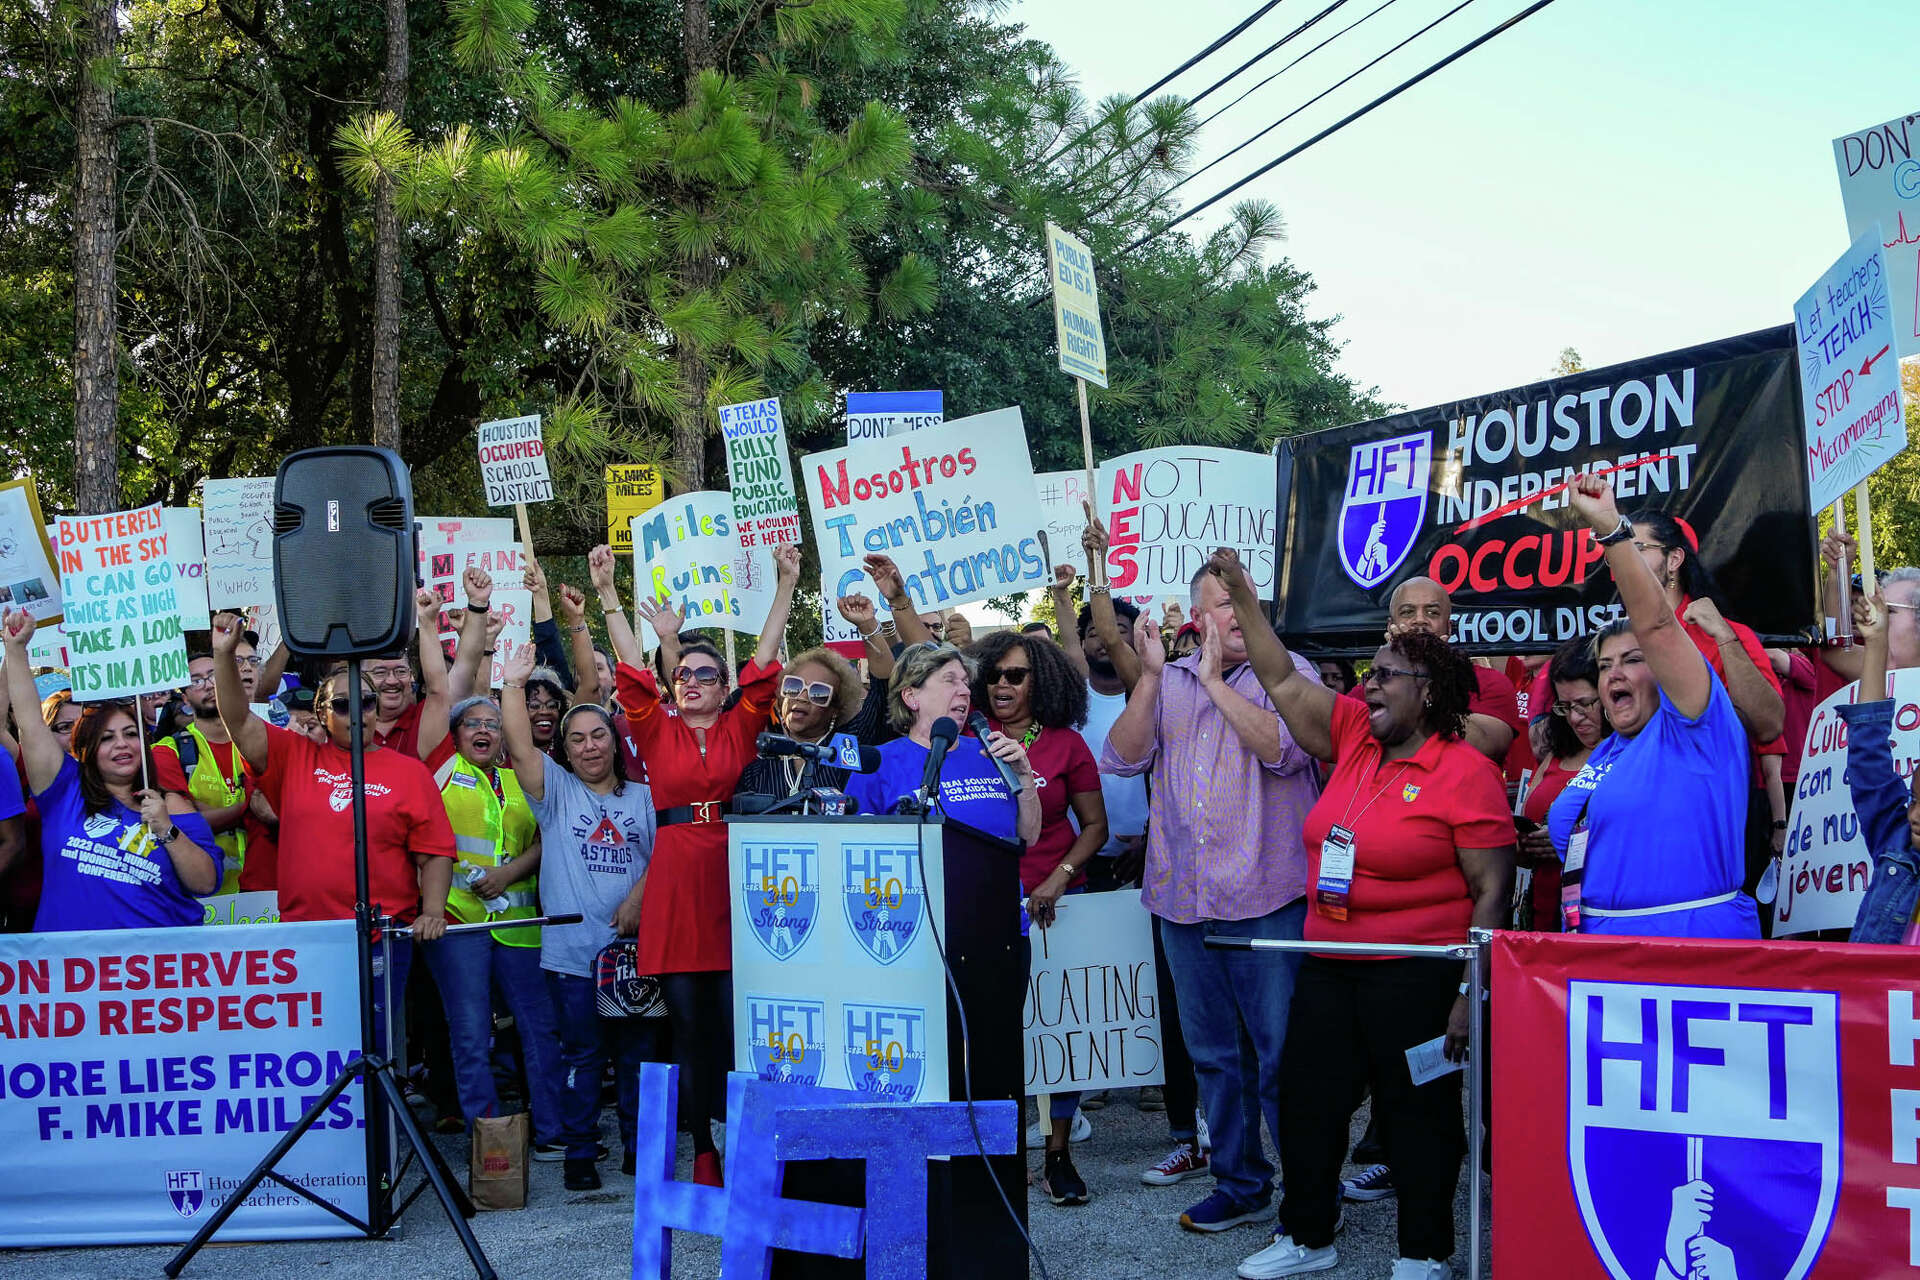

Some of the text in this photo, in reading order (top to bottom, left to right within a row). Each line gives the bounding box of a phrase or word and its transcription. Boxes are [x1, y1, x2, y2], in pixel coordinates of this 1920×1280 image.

[1842, 114, 1920, 177] DON'
[1055, 238, 1089, 274] PUBLIC
[1058, 261, 1092, 297] ED IS A
[1798, 253, 1880, 344] Let teachers
[1062, 307, 1098, 342] HUMAN
[1818, 294, 1873, 366] TEACH
[1066, 331, 1099, 362] RIGHT!
[720, 400, 778, 424] IF TEXAS
[1815, 369, 1854, 427] STOP
[482, 420, 538, 443] HOUSTON
[723, 417, 778, 439] WOULD
[1449, 368, 1696, 467] HOUSTON
[479, 440, 544, 464] OCCUPIED
[729, 434, 778, 461] FULLY
[1808, 390, 1900, 482] Micromanaging
[486, 461, 542, 483] SCHOOL
[733, 456, 781, 484] FUND
[817, 446, 977, 510] Nosotros
[1112, 457, 1220, 505] NOT
[1351, 438, 1426, 499] HFT
[489, 480, 551, 503] DISTRICT
[616, 485, 653, 497] MILES
[732, 481, 788, 502] PUBLIC
[59, 506, 162, 546] BUTTERFLY
[642, 503, 730, 563] Miles
[737, 521, 753, 534] WE
[740, 527, 798, 548] BE HERE!
[825, 490, 997, 558] También
[1109, 501, 1275, 547] EDUCATING
[61, 532, 168, 574] IN THE SKY
[65, 561, 172, 596] I CAN GO
[651, 561, 733, 605] Ruins
[63, 599, 113, 625] TWICE
[115, 596, 138, 620] AS
[141, 587, 177, 616] HIGH
[66, 614, 184, 654] TAKE A LOOK
[71, 662, 101, 691] IT'S
[106, 662, 127, 689] IN
[131, 658, 145, 687] A
[149, 649, 189, 684] BOOK
[941, 780, 962, 788] REAL
[944, 786, 964, 796] FOR
[965, 785, 987, 793] KIDS
[1799, 766, 1832, 800] con
[66, 836, 93, 851] 2023
[1787, 811, 1858, 858] de nu
[581, 844, 632, 864] ASTROS
[745, 848, 815, 890] HFT
[845, 849, 919, 891] HFT
[762, 876, 799, 907] 50
[864, 877, 903, 910] 50
[1780, 860, 1869, 922] jóven
[754, 907, 810, 935] Strong
[855, 910, 916, 939] Strong
[64, 949, 298, 993] DESERVES
[99, 992, 323, 1036] RESPECT!
[751, 1003, 820, 1043] HFT
[847, 1010, 921, 1052] HFT
[768, 1032, 805, 1063] 50
[866, 1039, 904, 1073] 50
[1587, 995, 1813, 1120] HFT
[0, 1059, 107, 1099] ORE
[119, 1055, 217, 1094] LIES
[856, 1071, 916, 1102] Strong
[38, 1106, 73, 1141] F.
[86, 1100, 203, 1140] MIKE
[167, 1171, 200, 1189] HFT
